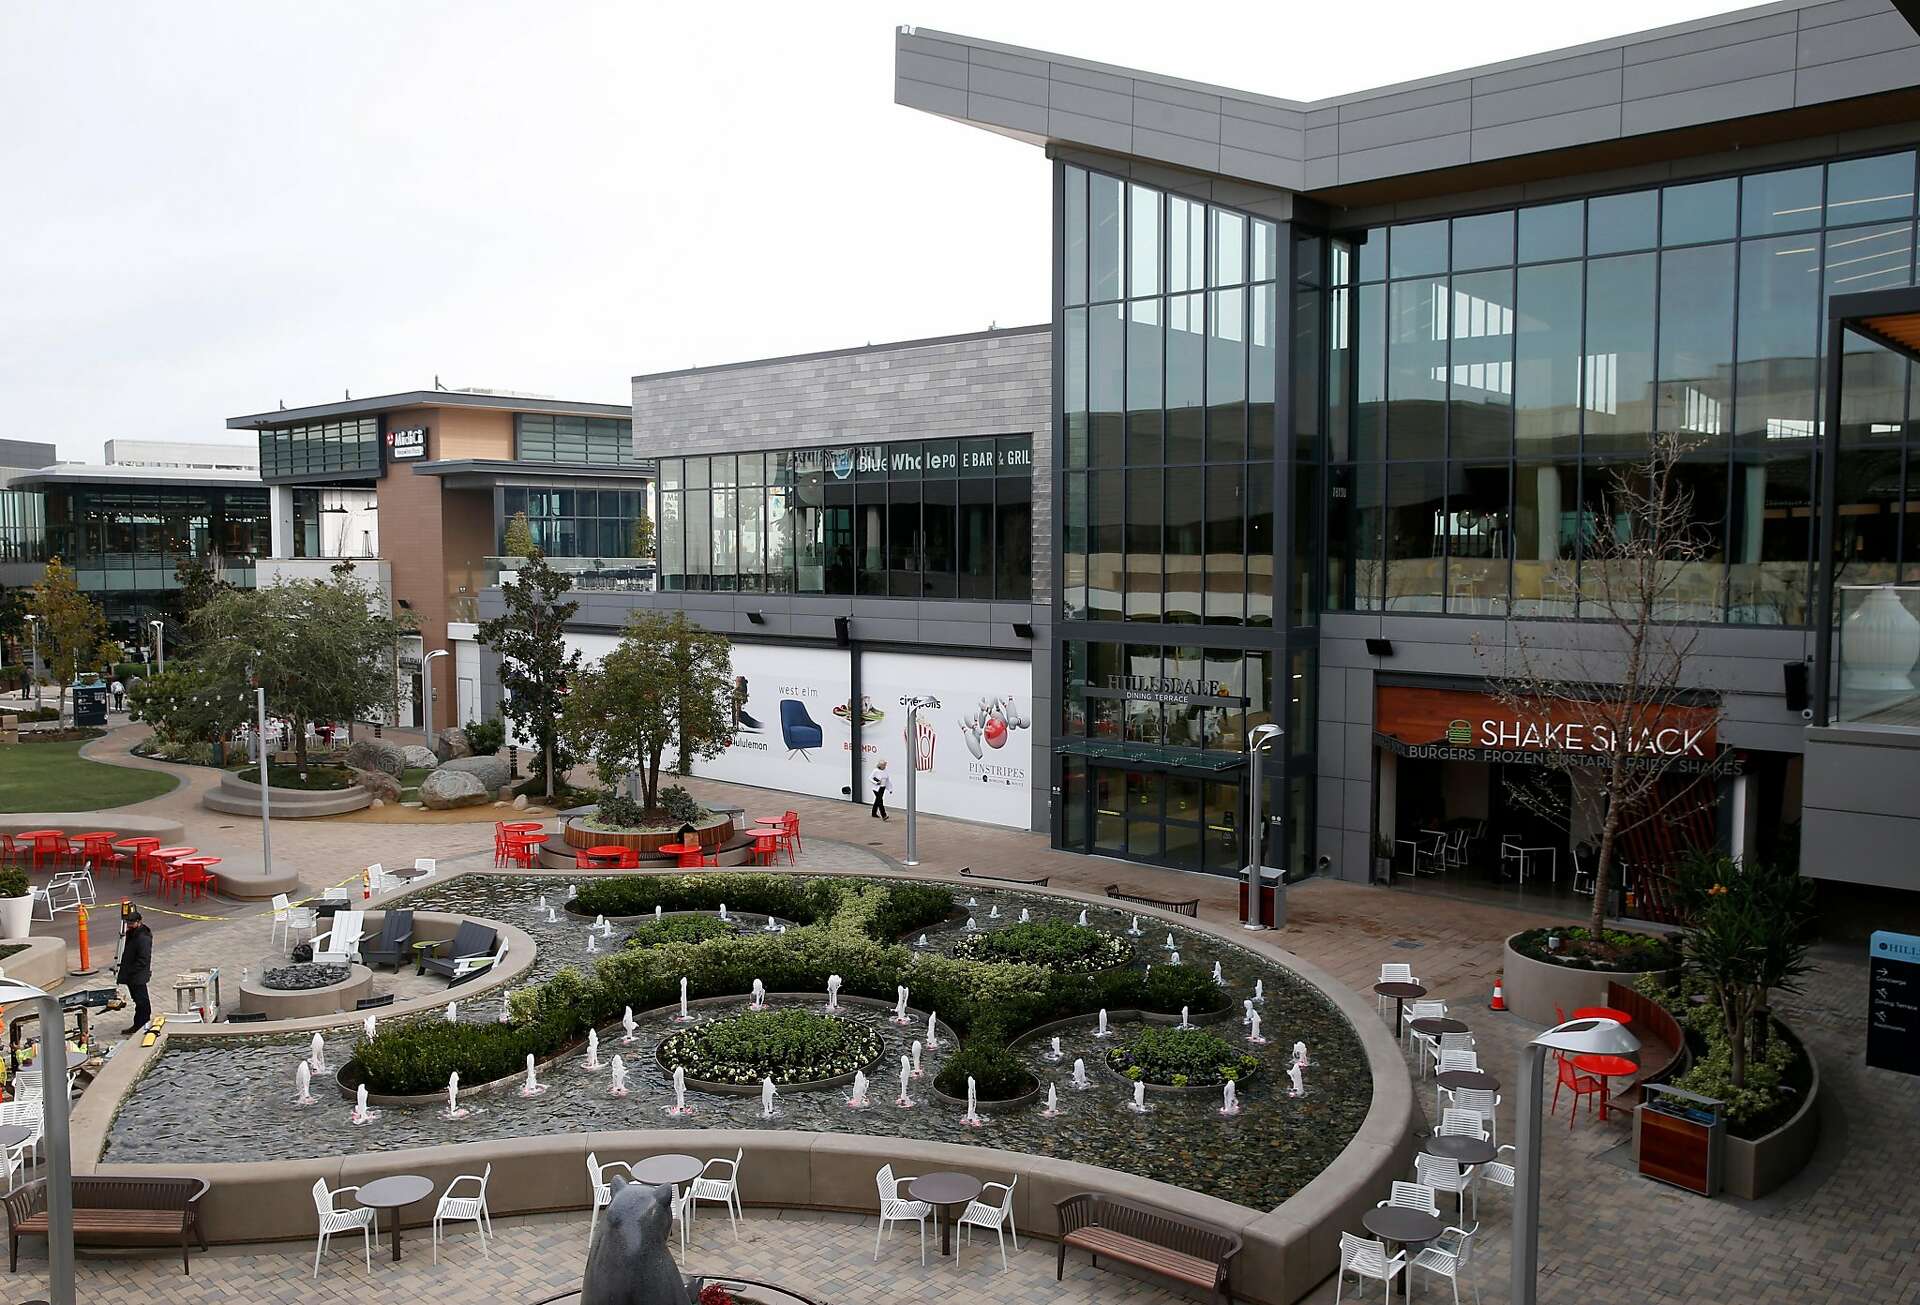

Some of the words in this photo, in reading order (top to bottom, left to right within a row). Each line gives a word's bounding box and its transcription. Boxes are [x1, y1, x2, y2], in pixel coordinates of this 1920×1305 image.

[859, 455, 887, 473] Blue
[942, 453, 969, 468] POE
[972, 452, 993, 467] BAR
[1007, 450, 1031, 465] GRIL
[778, 685, 799, 696] west
[801, 687, 818, 697] elm
[1126, 691, 1152, 700] DINING
[1154, 693, 1188, 703] TERRACE
[1480, 719, 1584, 750] SHAKE
[1590, 725, 1705, 756] SHACK
[843, 741, 878, 754] BEMPO
[1409, 745, 1476, 761] BURGERS
[1484, 750, 1544, 765] FROZEN
[1679, 760, 1744, 776] SHAKES
[968, 761, 1025, 779] PINSTRIPES
[1889, 943, 1920, 957] HILL
